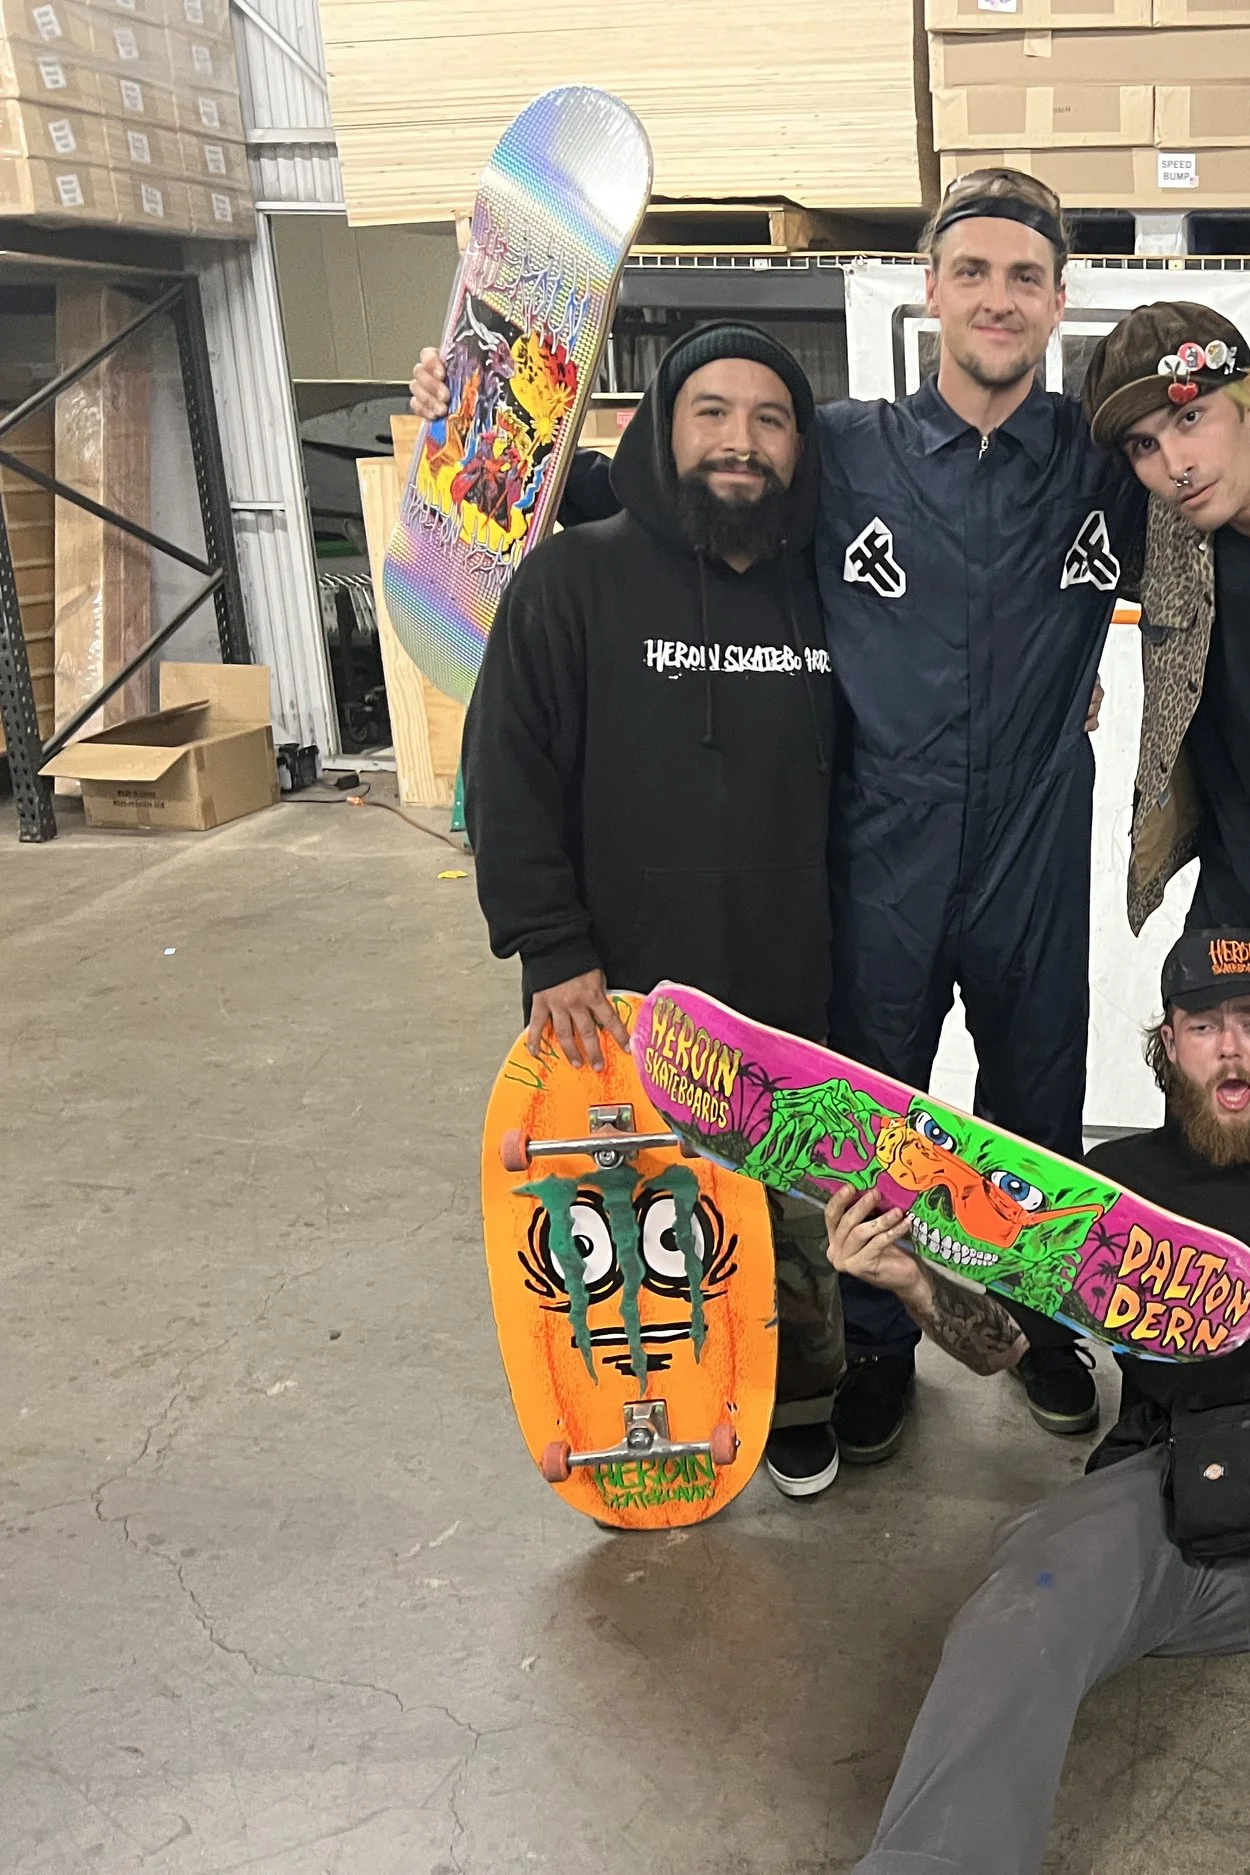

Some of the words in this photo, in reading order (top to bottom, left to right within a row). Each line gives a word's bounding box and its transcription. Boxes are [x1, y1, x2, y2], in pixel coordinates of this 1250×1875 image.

[1161, 160, 1192, 168] SPEED
[1163, 172, 1190, 180] BUMP
[652, 996, 744, 1098] HEROIN
[644, 1047, 729, 1129] SKATEBOARDS
[1104, 1282, 1230, 1351] DERN
